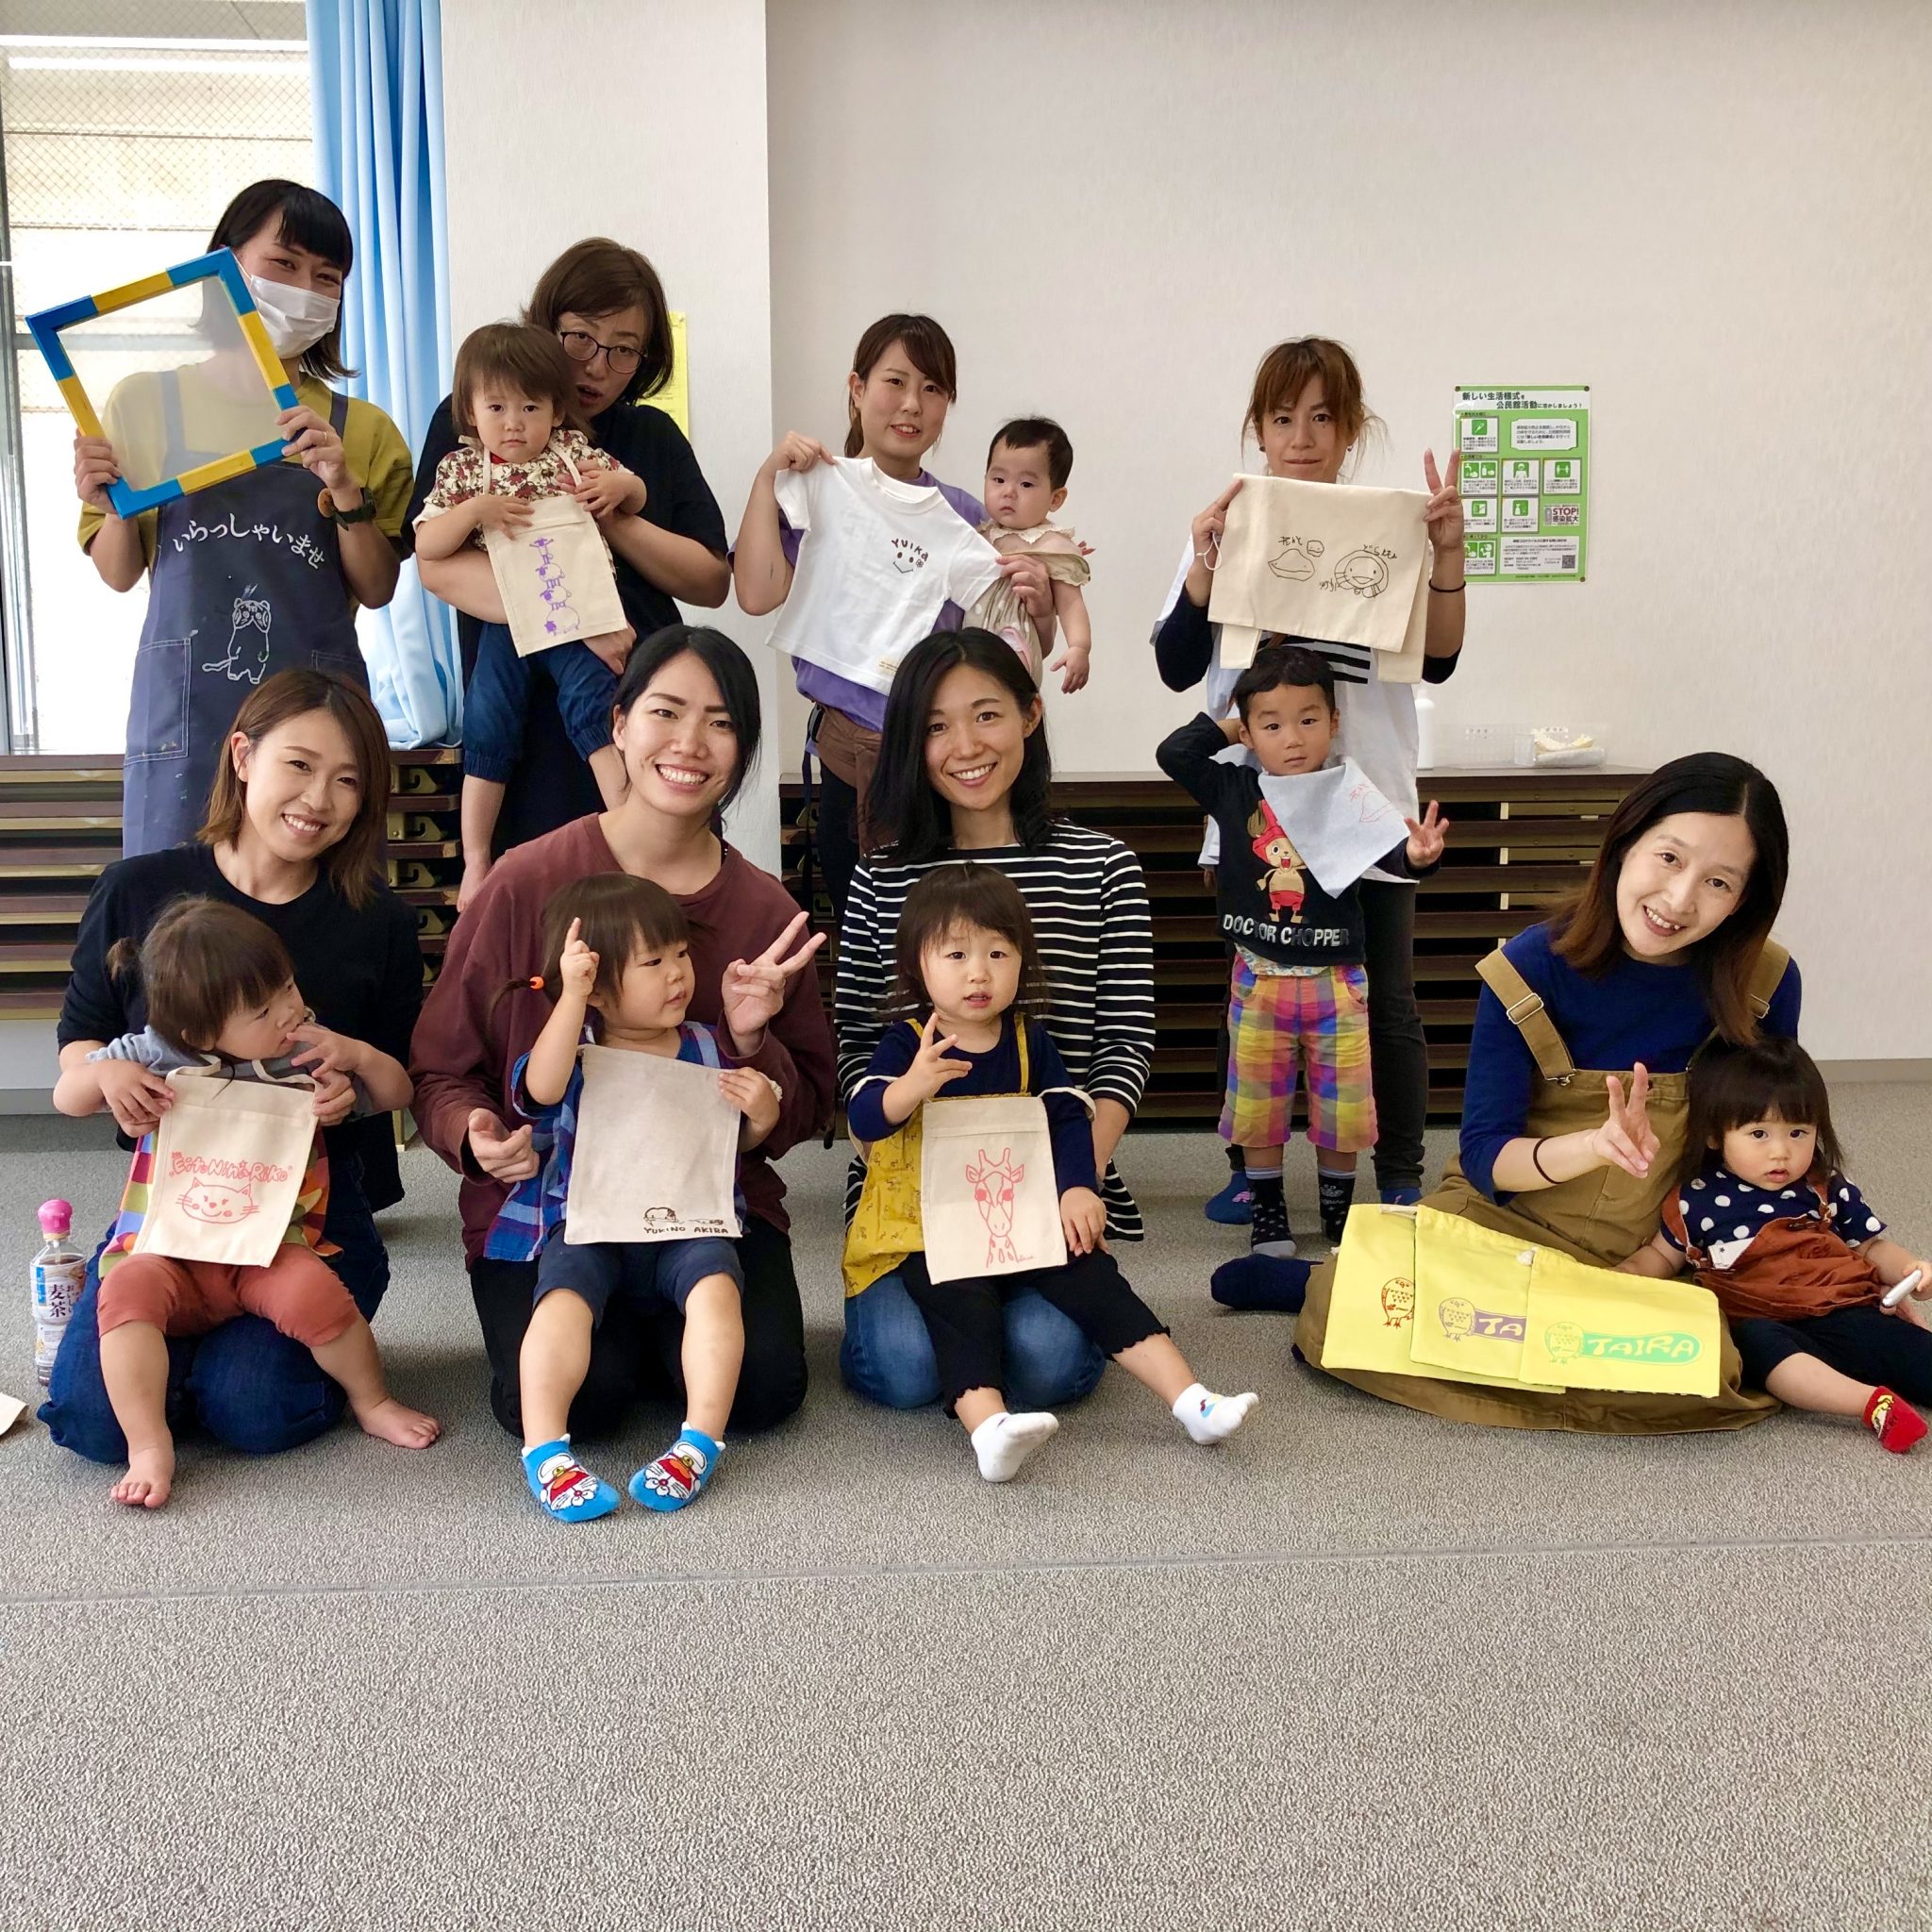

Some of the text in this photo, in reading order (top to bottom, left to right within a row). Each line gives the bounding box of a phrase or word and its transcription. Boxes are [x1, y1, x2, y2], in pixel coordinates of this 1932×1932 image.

[1553, 508, 1579, 516] STOP!
[173, 513, 325, 569] いらっしゃいませ
[1280, 926, 1350, 947] CHOPPER
[643, 1226, 686, 1235] YUKINO
[49, 1284, 66, 1318] 麦茶
[1588, 1335, 1694, 1358] TAIRA
